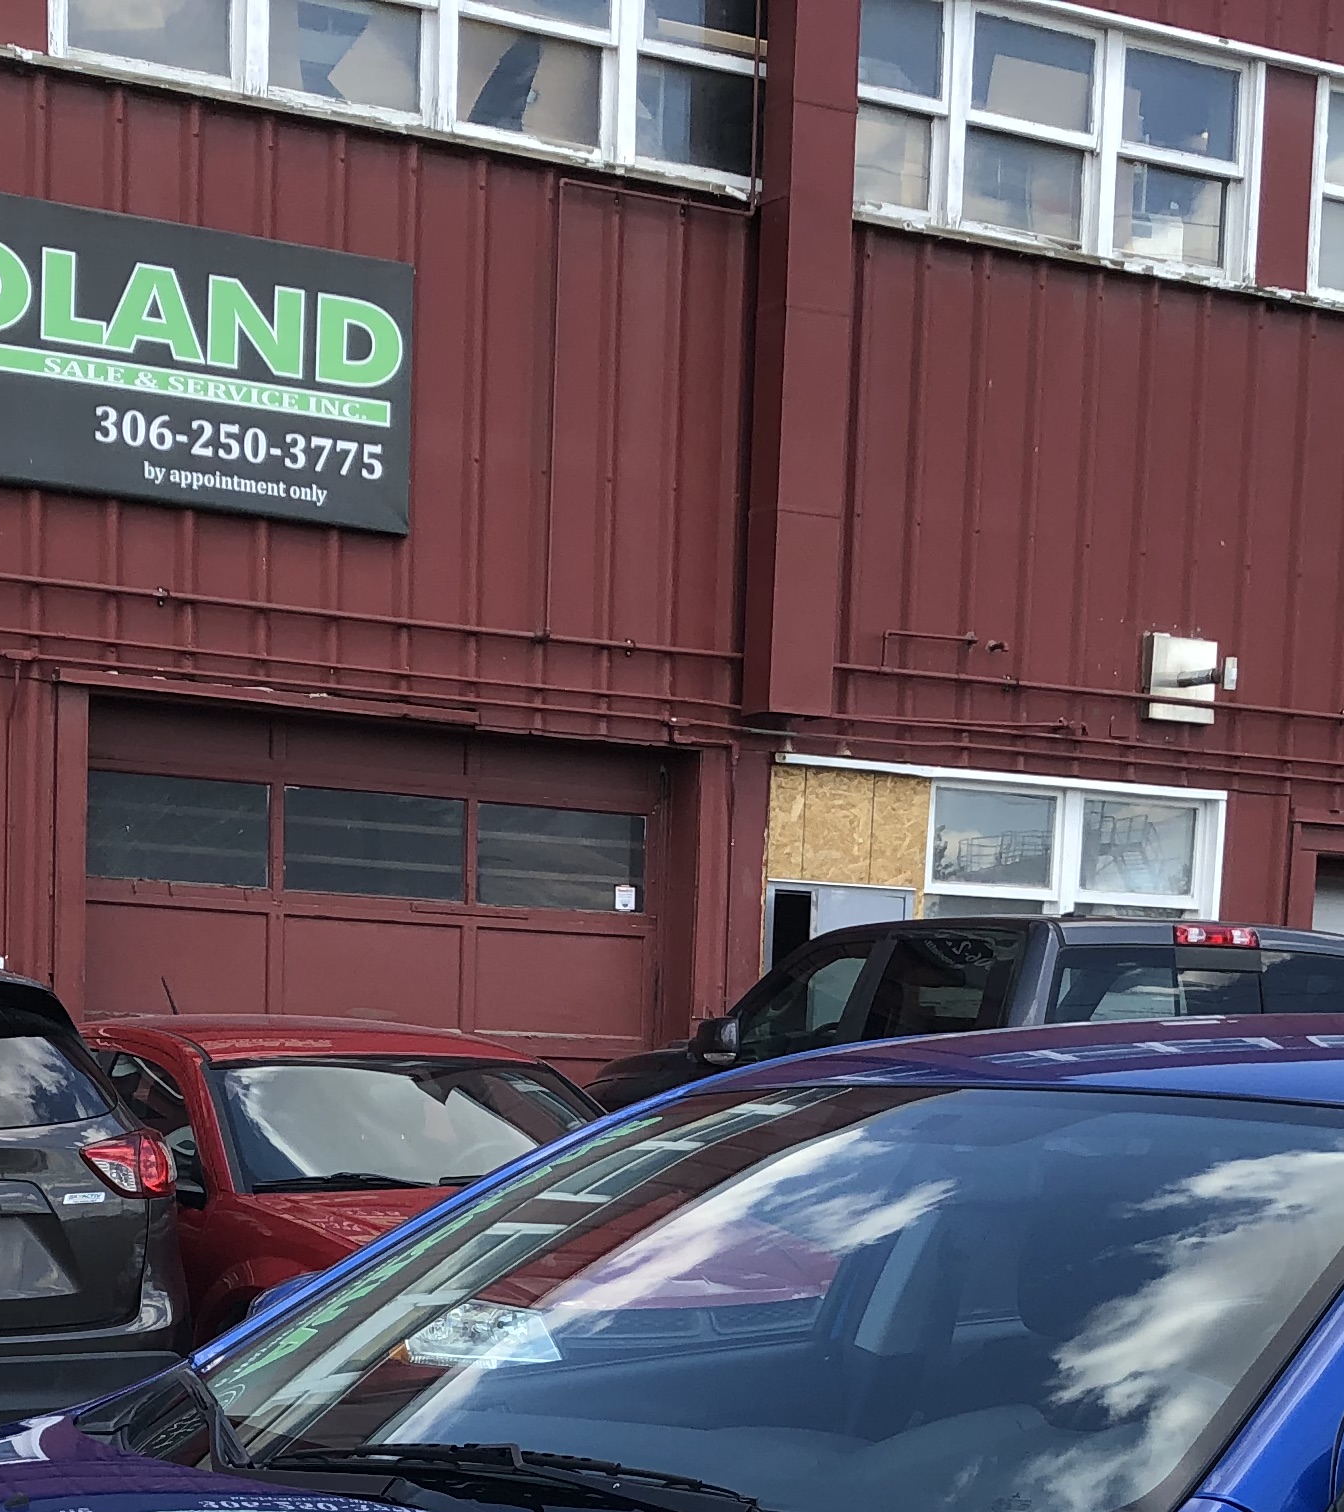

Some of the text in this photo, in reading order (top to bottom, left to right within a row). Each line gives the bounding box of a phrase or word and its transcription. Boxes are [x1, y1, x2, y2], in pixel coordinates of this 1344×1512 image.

[43, 357, 367, 420] SALE & SERVICE INC.
[94, 405, 383, 480] 306-250-3775
[143, 460, 328, 507] by appointment only
